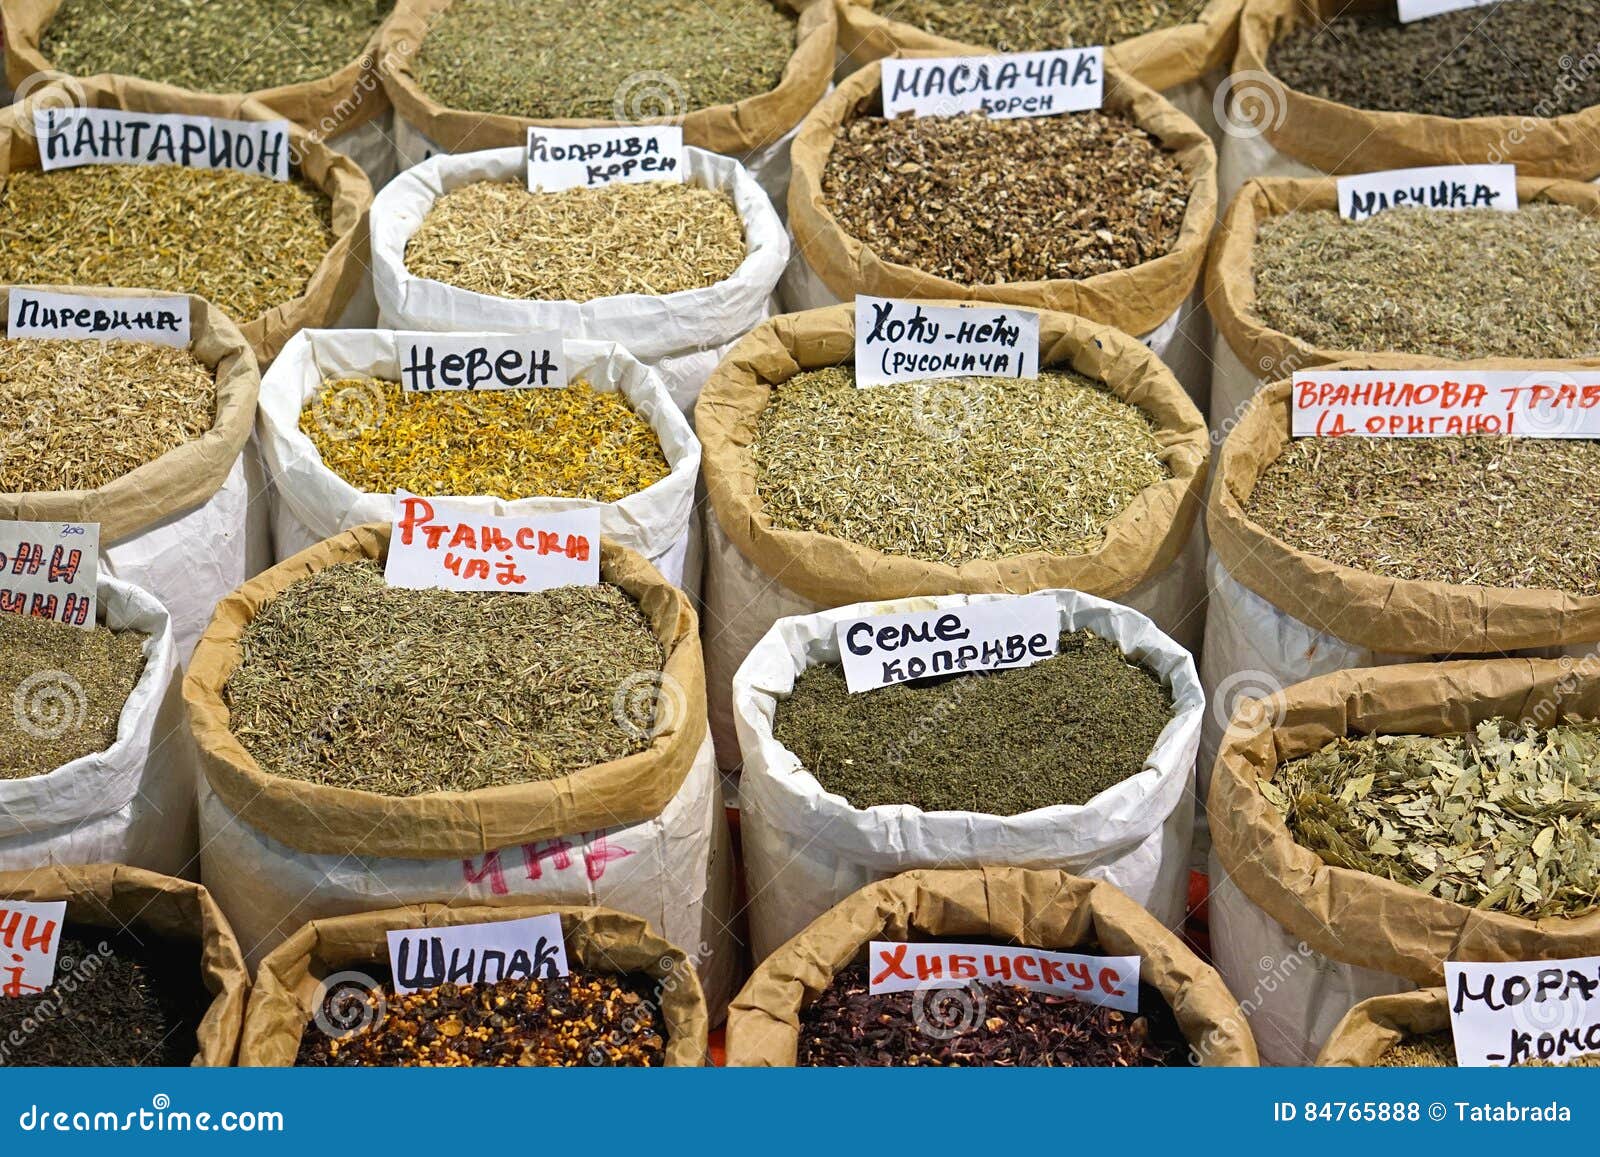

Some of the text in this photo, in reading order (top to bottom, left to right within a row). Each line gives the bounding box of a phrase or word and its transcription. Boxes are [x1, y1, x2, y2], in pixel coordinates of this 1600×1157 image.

[891, 53, 1098, 102] МАСЛАЧАК
[47, 110, 283, 176] КАНТАРИОН
[1295, 381, 1489, 410] ВРАНИЛОВА
[1453, 966, 1600, 1016] МОРА
